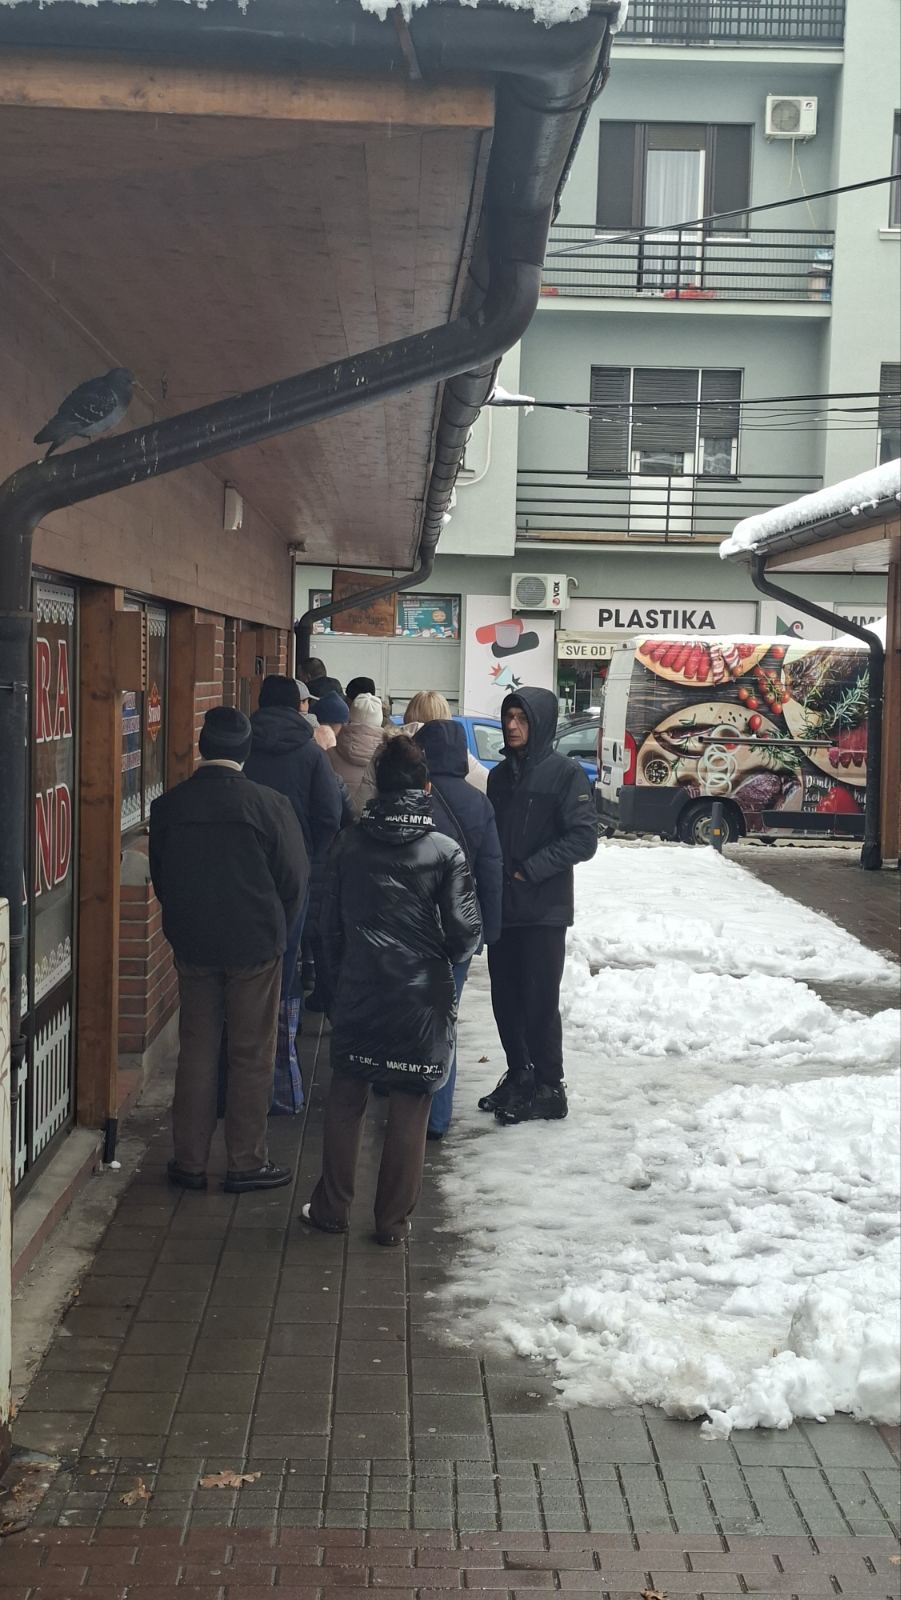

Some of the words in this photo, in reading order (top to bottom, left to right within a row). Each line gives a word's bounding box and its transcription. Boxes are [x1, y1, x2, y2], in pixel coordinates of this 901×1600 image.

[598, 608, 716, 629] PLASTIKA
[566, 645, 588, 656] SVE
[590, 646, 607, 656] OD
[409, 815, 422, 824] MY
[386, 1060, 408, 1071] MAKE
[408, 1063, 422, 1073] MY
